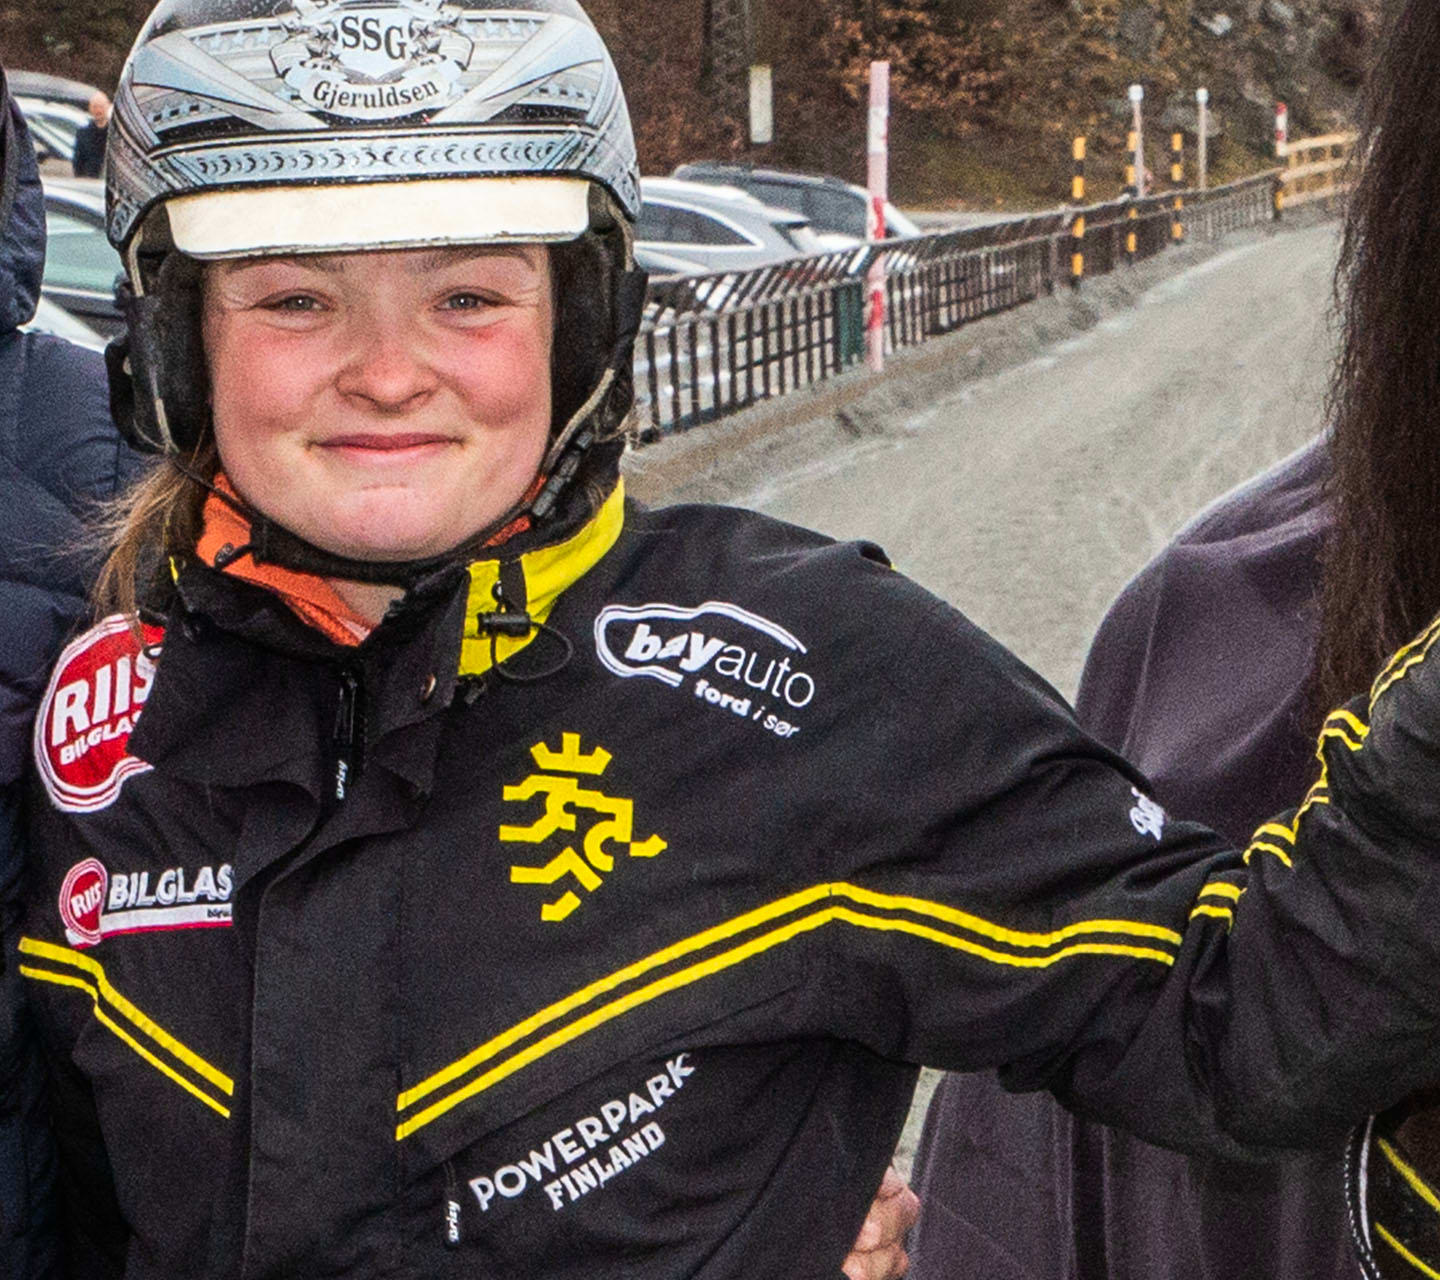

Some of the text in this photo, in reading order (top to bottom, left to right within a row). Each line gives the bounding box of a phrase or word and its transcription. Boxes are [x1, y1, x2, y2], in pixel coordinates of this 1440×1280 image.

[341, 16, 408, 60] SSG
[313, 78, 440, 109] Gjeruldsen
[694, 679, 751, 716] ford
[70, 882, 102, 918] RIIS
[469, 1052, 695, 1211] POWERPARK
[544, 1121, 666, 1211] FINLAND
